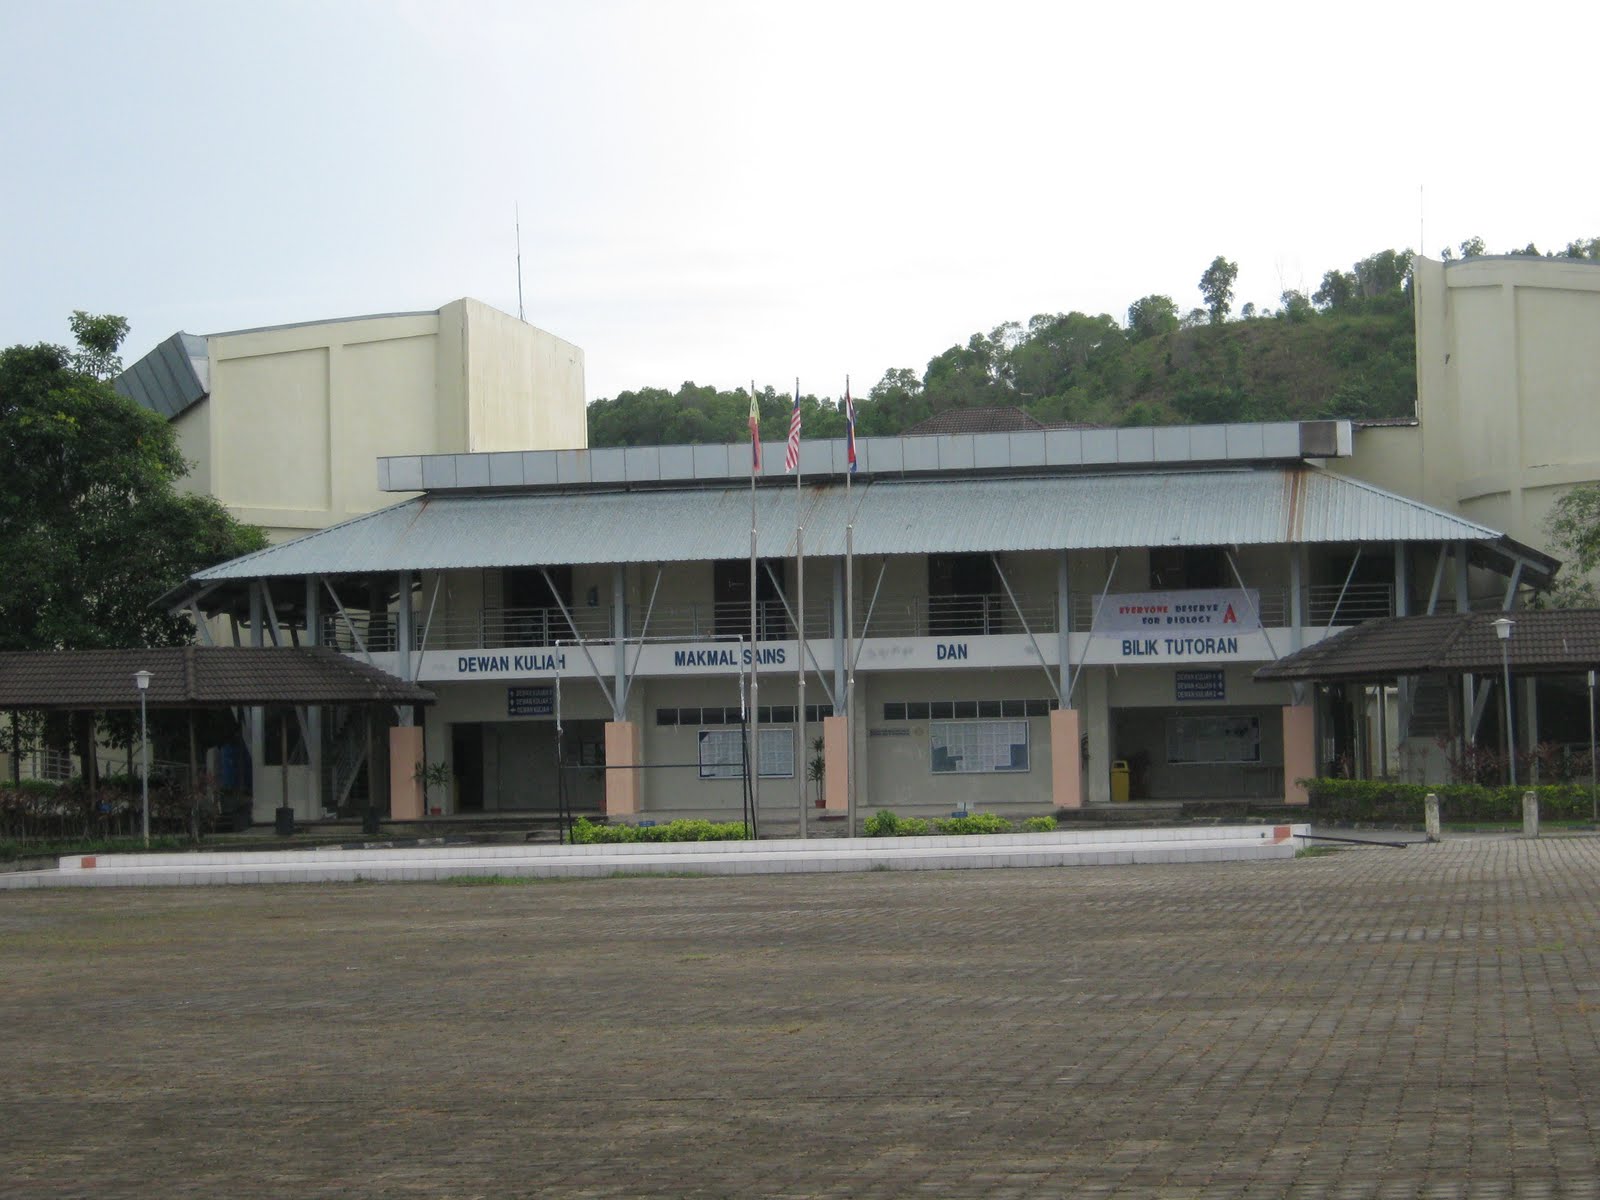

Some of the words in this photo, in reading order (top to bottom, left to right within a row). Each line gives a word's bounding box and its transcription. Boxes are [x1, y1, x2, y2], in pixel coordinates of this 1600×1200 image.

[1119, 605, 1169, 615] EVERYONE
[1175, 603, 1219, 613] DESERVE
[1223, 602, 1237, 624] A
[1142, 617, 1160, 625] FOR
[1166, 615, 1212, 625] BIOLOGY
[936, 643, 968, 660] DAN
[1122, 639, 1159, 656] BILIK
[1165, 637, 1238, 656] TUTORAN
[458, 655, 509, 672] DEWAN
[514, 653, 566, 671] KULIAH
[674, 649, 738, 667] MAKMAL
[743, 647, 786, 665] SAINS
